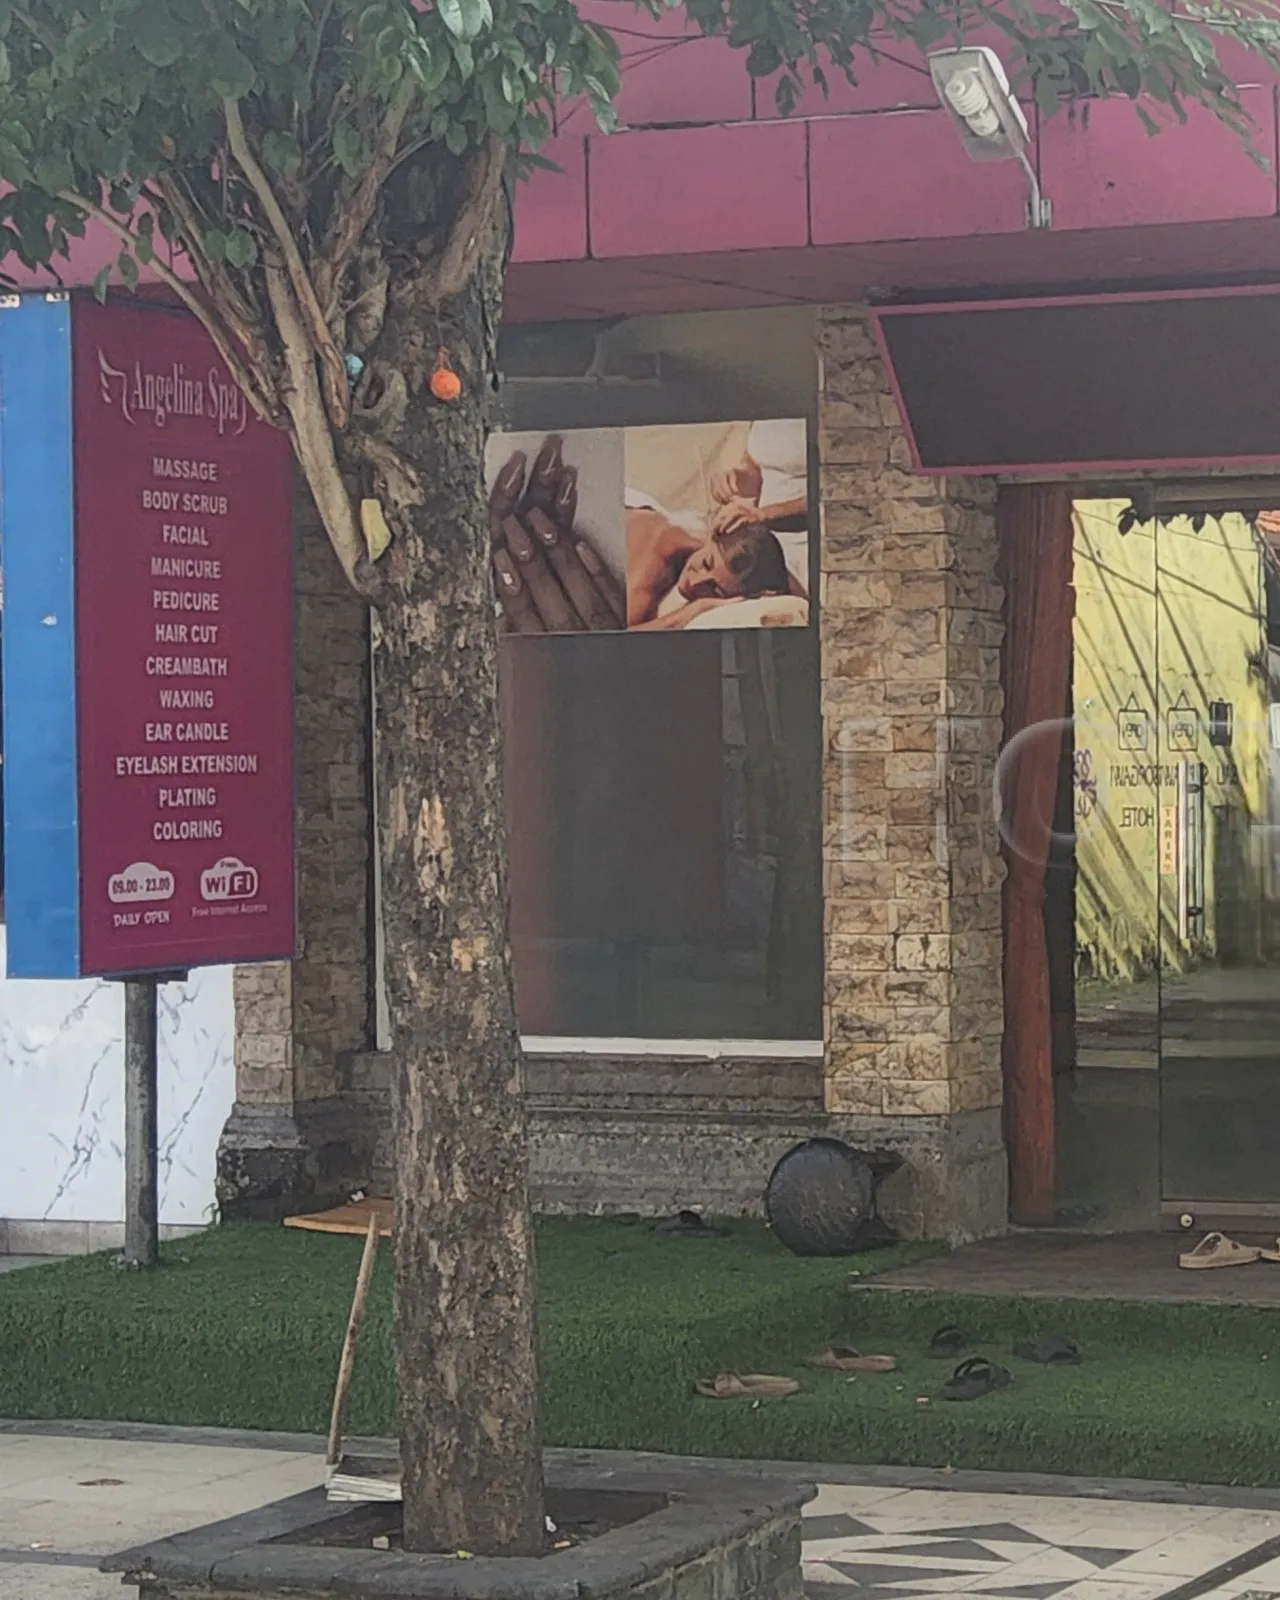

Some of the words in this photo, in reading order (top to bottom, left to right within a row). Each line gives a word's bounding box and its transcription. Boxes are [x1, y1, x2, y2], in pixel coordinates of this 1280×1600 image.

[131, 360, 203, 427] Angelina
[207, 366, 239, 434] Spa
[153, 457, 218, 481] MASSAGE
[143, 490, 179, 511] BODY
[183, 494, 228, 515] SCRUB
[162, 524, 209, 546] FACIAL
[151, 557, 221, 579] MANICURE
[153, 590, 220, 611] PEDICURE
[155, 625, 188, 643] HAIR
[191, 625, 218, 643] CUT
[146, 657, 227, 676] CREAMBATH
[159, 690, 214, 708] WAXING
[145, 723, 172, 742] EAR
[176, 723, 229, 741] CANDLE
[116, 756, 178, 775] EYELASH
[182, 755, 258, 774] EXTENSION
[159, 788, 216, 808] PLATING
[153, 820, 222, 840] COLORING
[112, 879, 138, 895] 09.00
[145, 877, 170, 892] 23.00
[112, 911, 142, 928] DAILY
[144, 910, 170, 925] OPEN
[191, 905, 210, 917] Free
